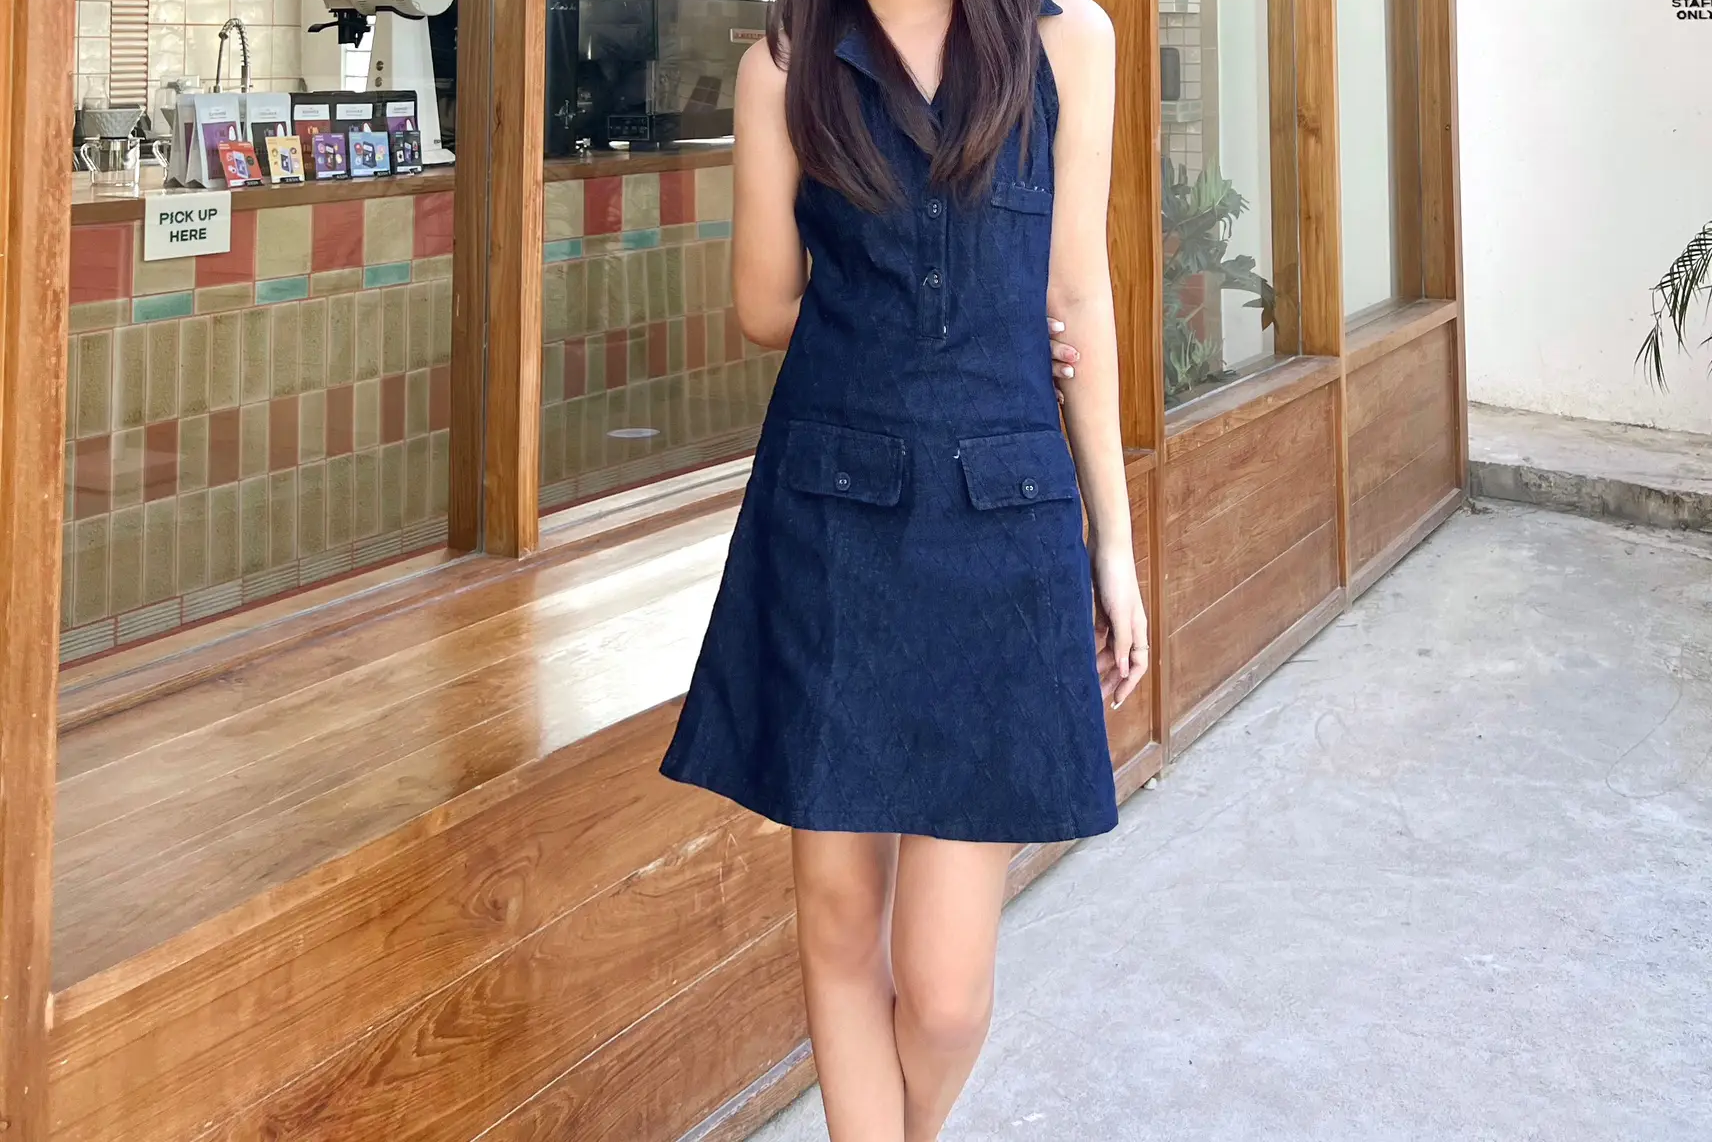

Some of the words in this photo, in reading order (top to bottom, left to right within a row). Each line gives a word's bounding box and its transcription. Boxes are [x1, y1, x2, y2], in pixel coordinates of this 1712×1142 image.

[159, 210, 194, 225] PICK
[198, 208, 218, 221] UP
[169, 228, 207, 243] HERE
